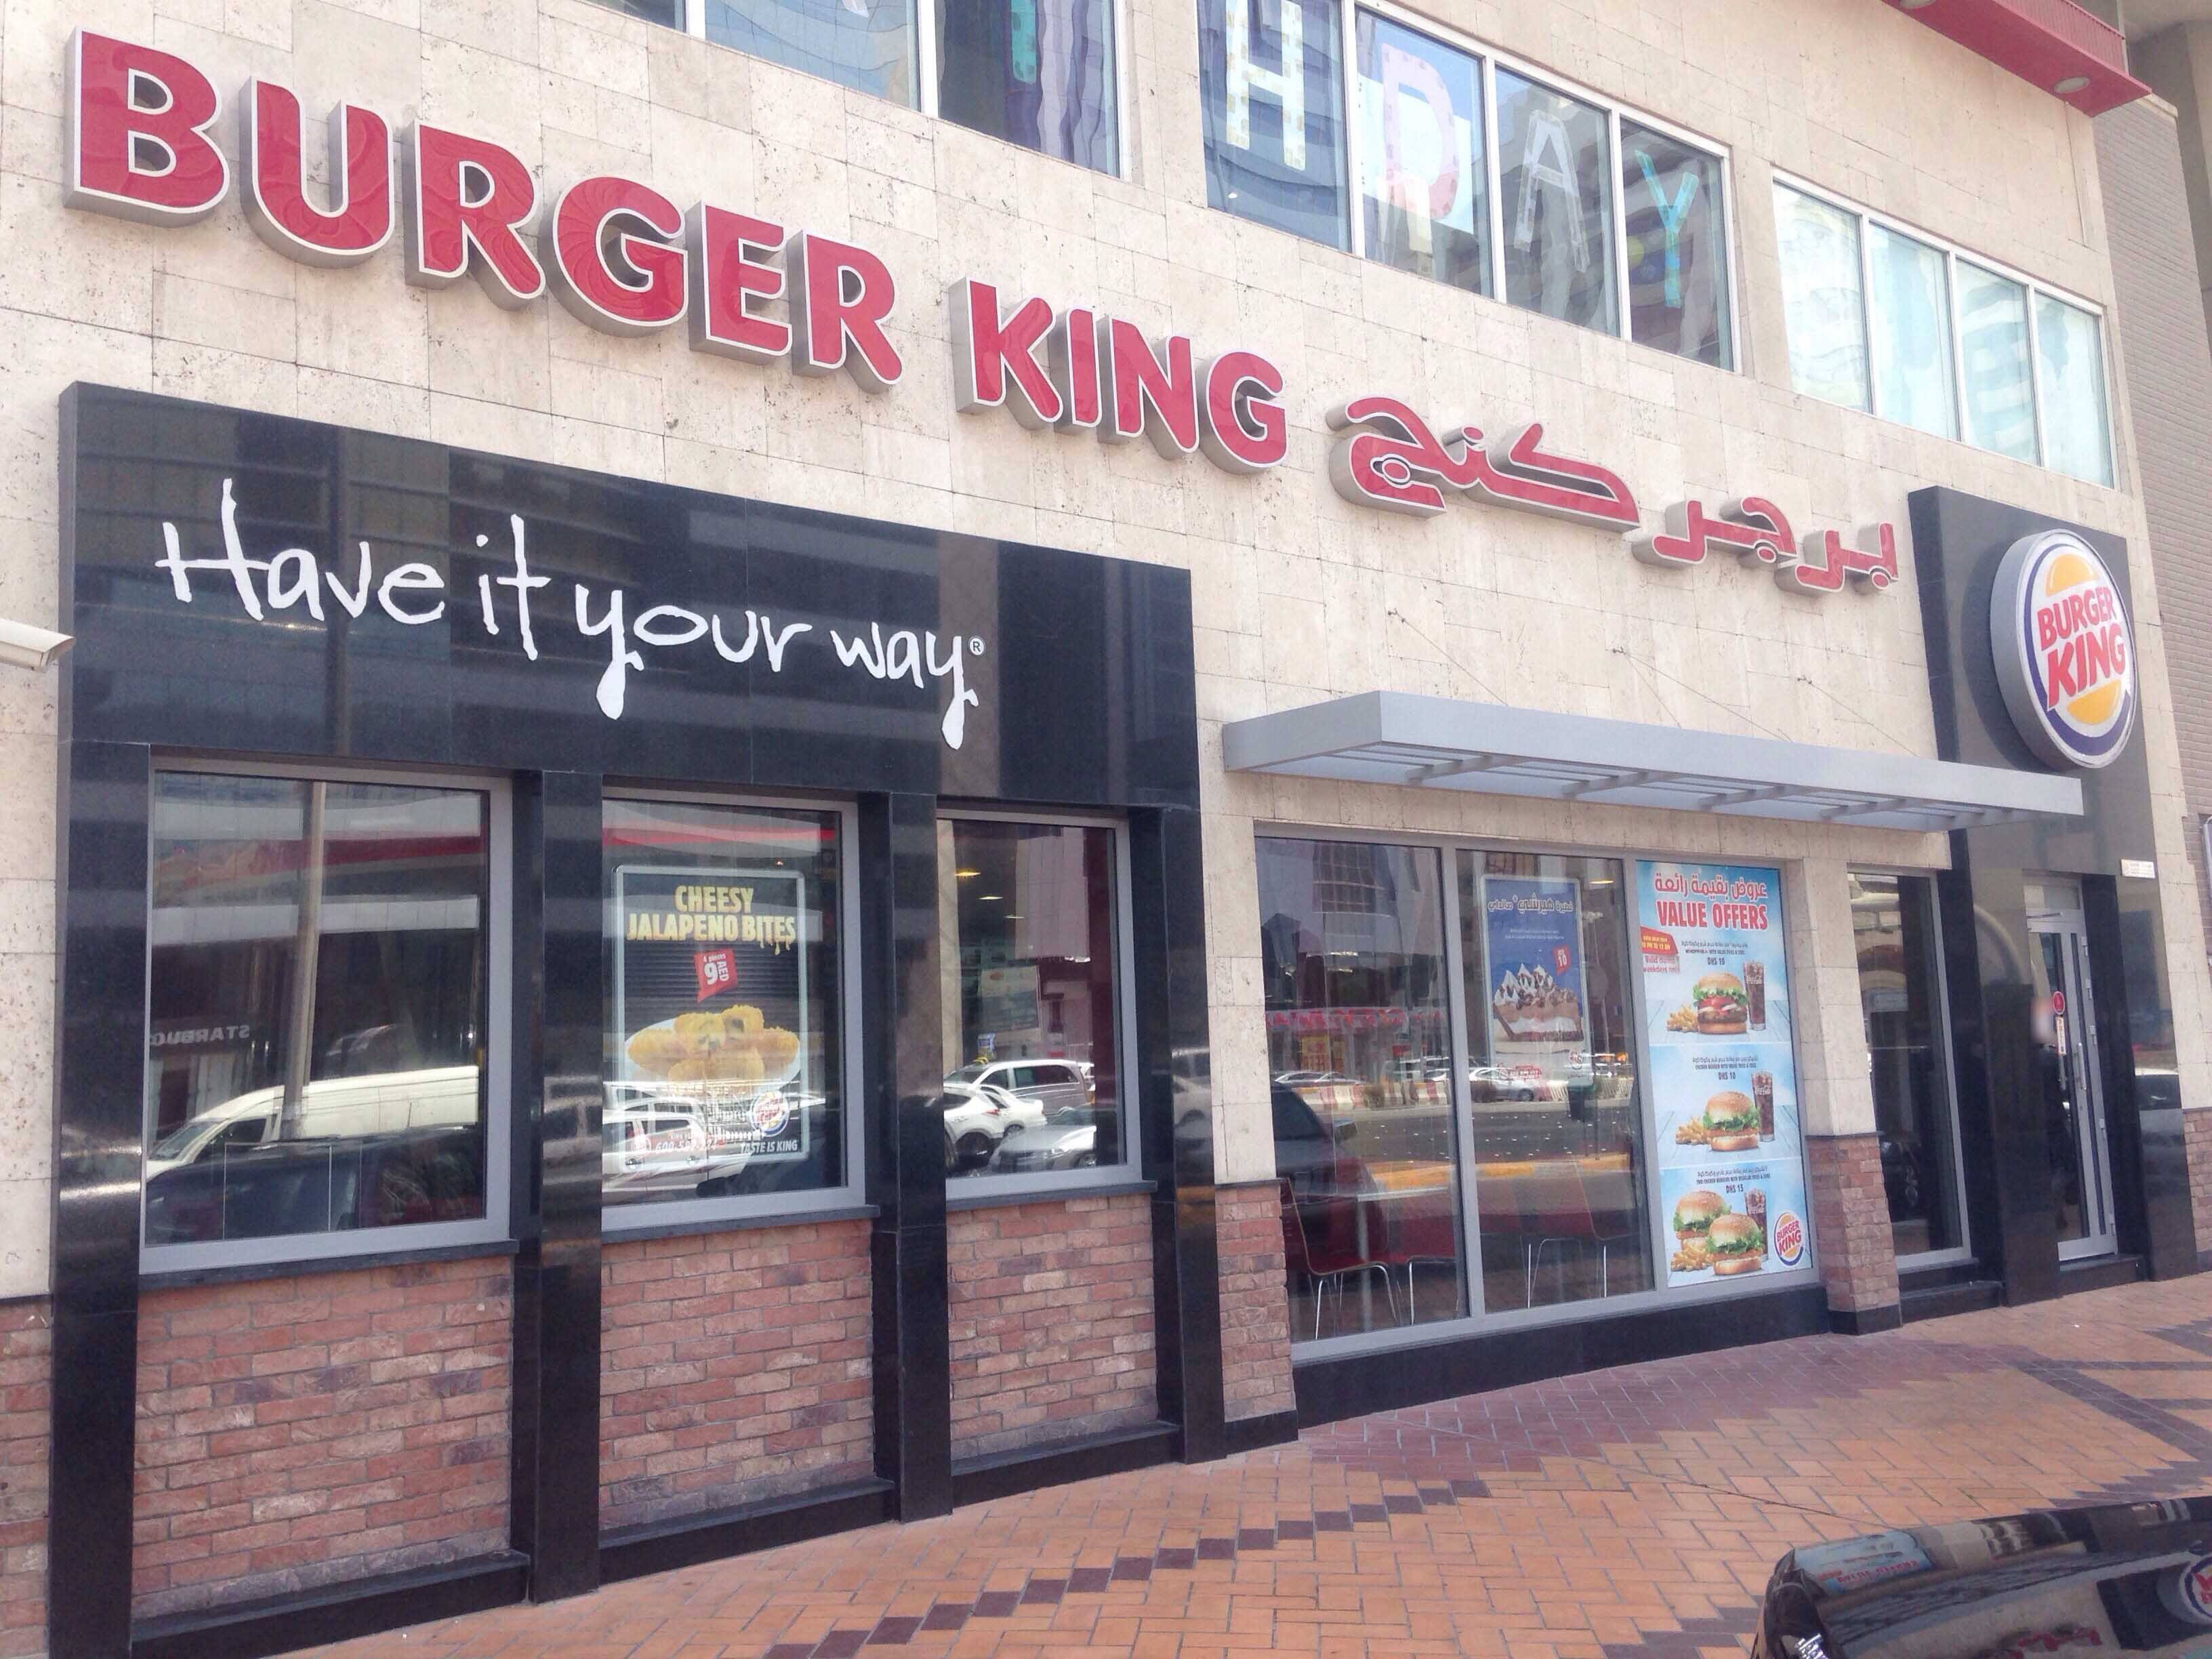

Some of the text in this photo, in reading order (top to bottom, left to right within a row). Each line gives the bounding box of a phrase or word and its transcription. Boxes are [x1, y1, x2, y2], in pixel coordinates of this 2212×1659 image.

[65, 27, 1286, 474] BURGER KING
[1326, 396, 1899, 596] برجر كنج
[155, 478, 445, 623] Have
[474, 513, 550, 661] it
[574, 581, 813, 720] your
[2036, 586, 2119, 651] BURGER
[2047, 623, 2126, 711] KING
[675, 885, 754, 914] CHEESY
[627, 913, 797, 947] JALAPENO BITES
[1656, 901, 1768, 930] VALUE OFFERS
[704, 963, 718, 985] 9
[717, 961, 729, 981] AED
[740, 1140, 798, 1154] TASTE IS KING
[1725, 1185, 1736, 1193] DHS
[1777, 1220, 1799, 1242] BURGER
[1778, 1229, 1801, 1256] KING
